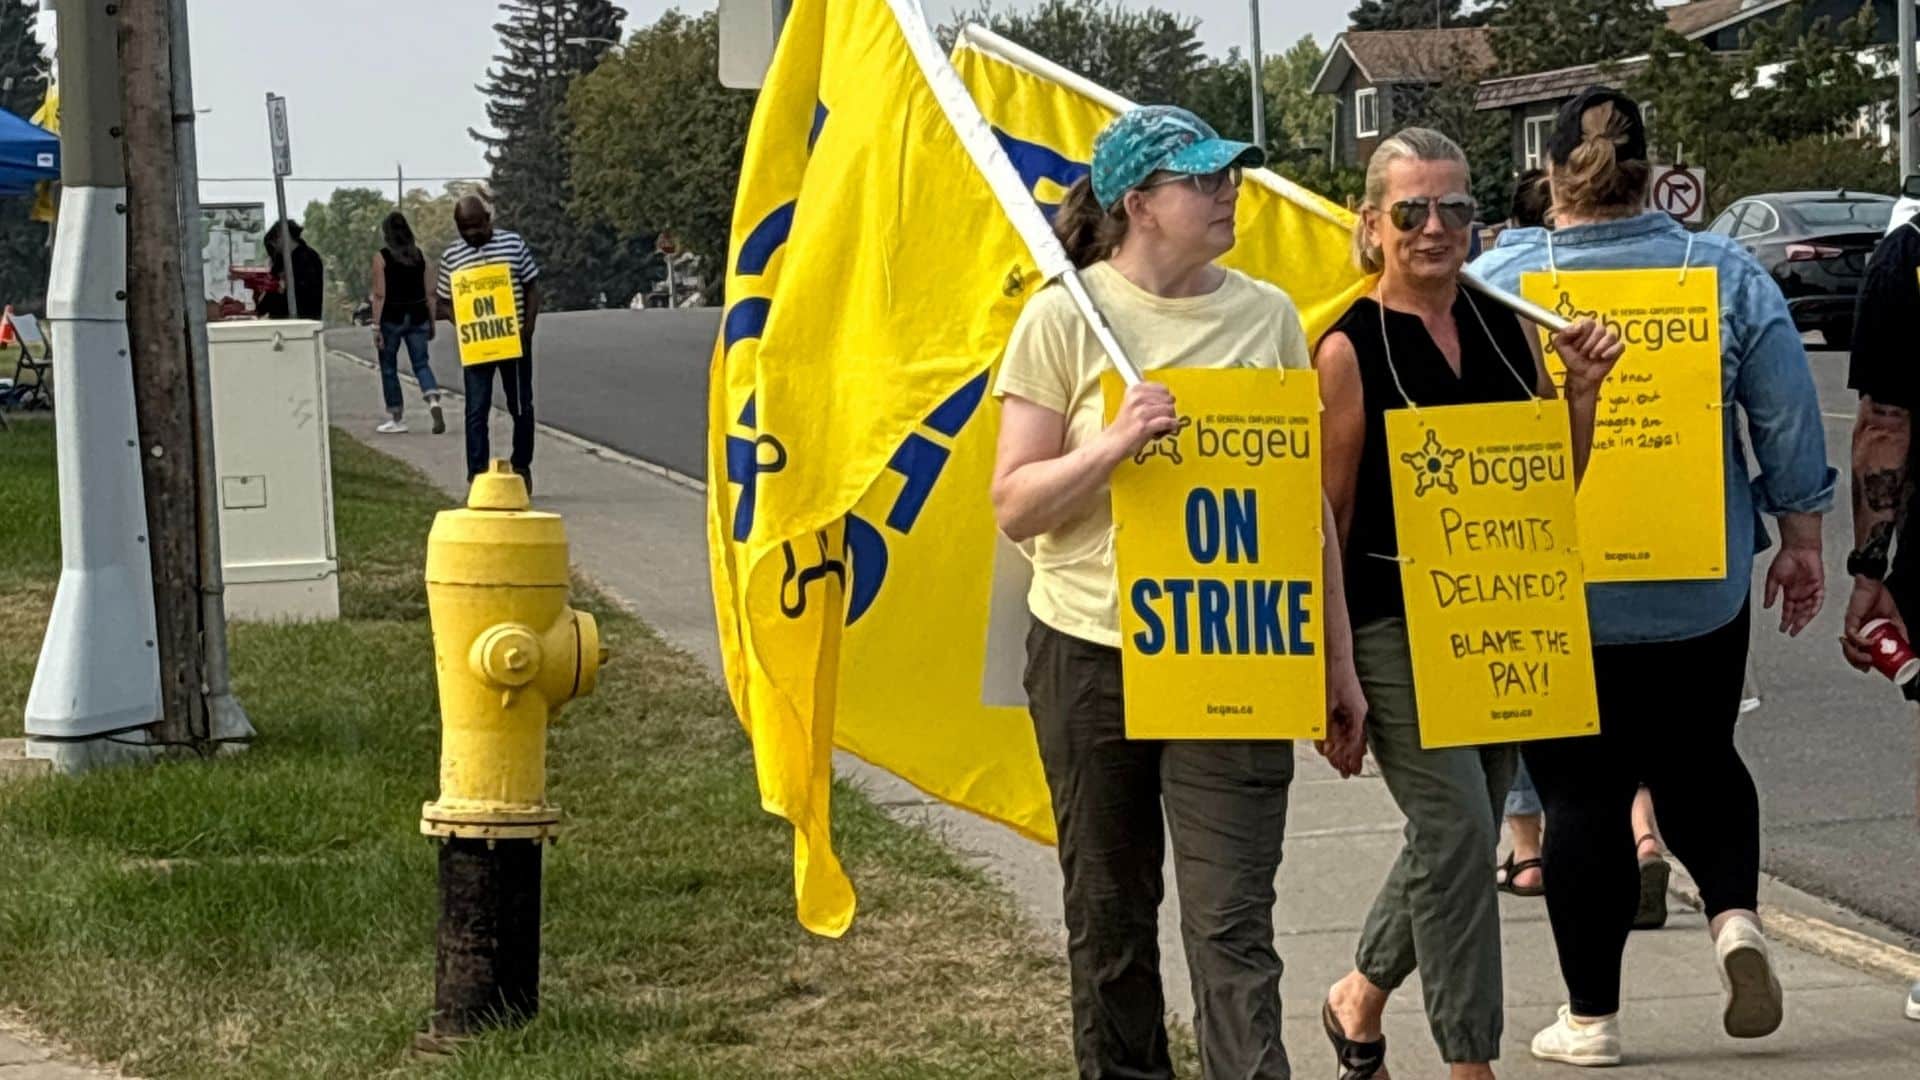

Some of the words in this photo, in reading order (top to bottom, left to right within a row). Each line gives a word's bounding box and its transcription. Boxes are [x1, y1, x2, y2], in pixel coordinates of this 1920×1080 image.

[473, 295, 496, 318] ON
[461, 316, 516, 344] STRIKE
[1197, 418, 1310, 466] bcgeu
[1469, 452, 1565, 491] bcgeu
[1185, 487, 1259, 564] ON
[1440, 507, 1554, 556] PERMITS
[1429, 569, 1568, 608] DELAYED?
[1131, 578, 1315, 656] STRIKE
[1450, 630, 1526, 658] BLAME
[1530, 630, 1571, 655] THE
[1488, 661, 1549, 697] PAY!
[1206, 704, 1253, 716] bcgeu.ca
